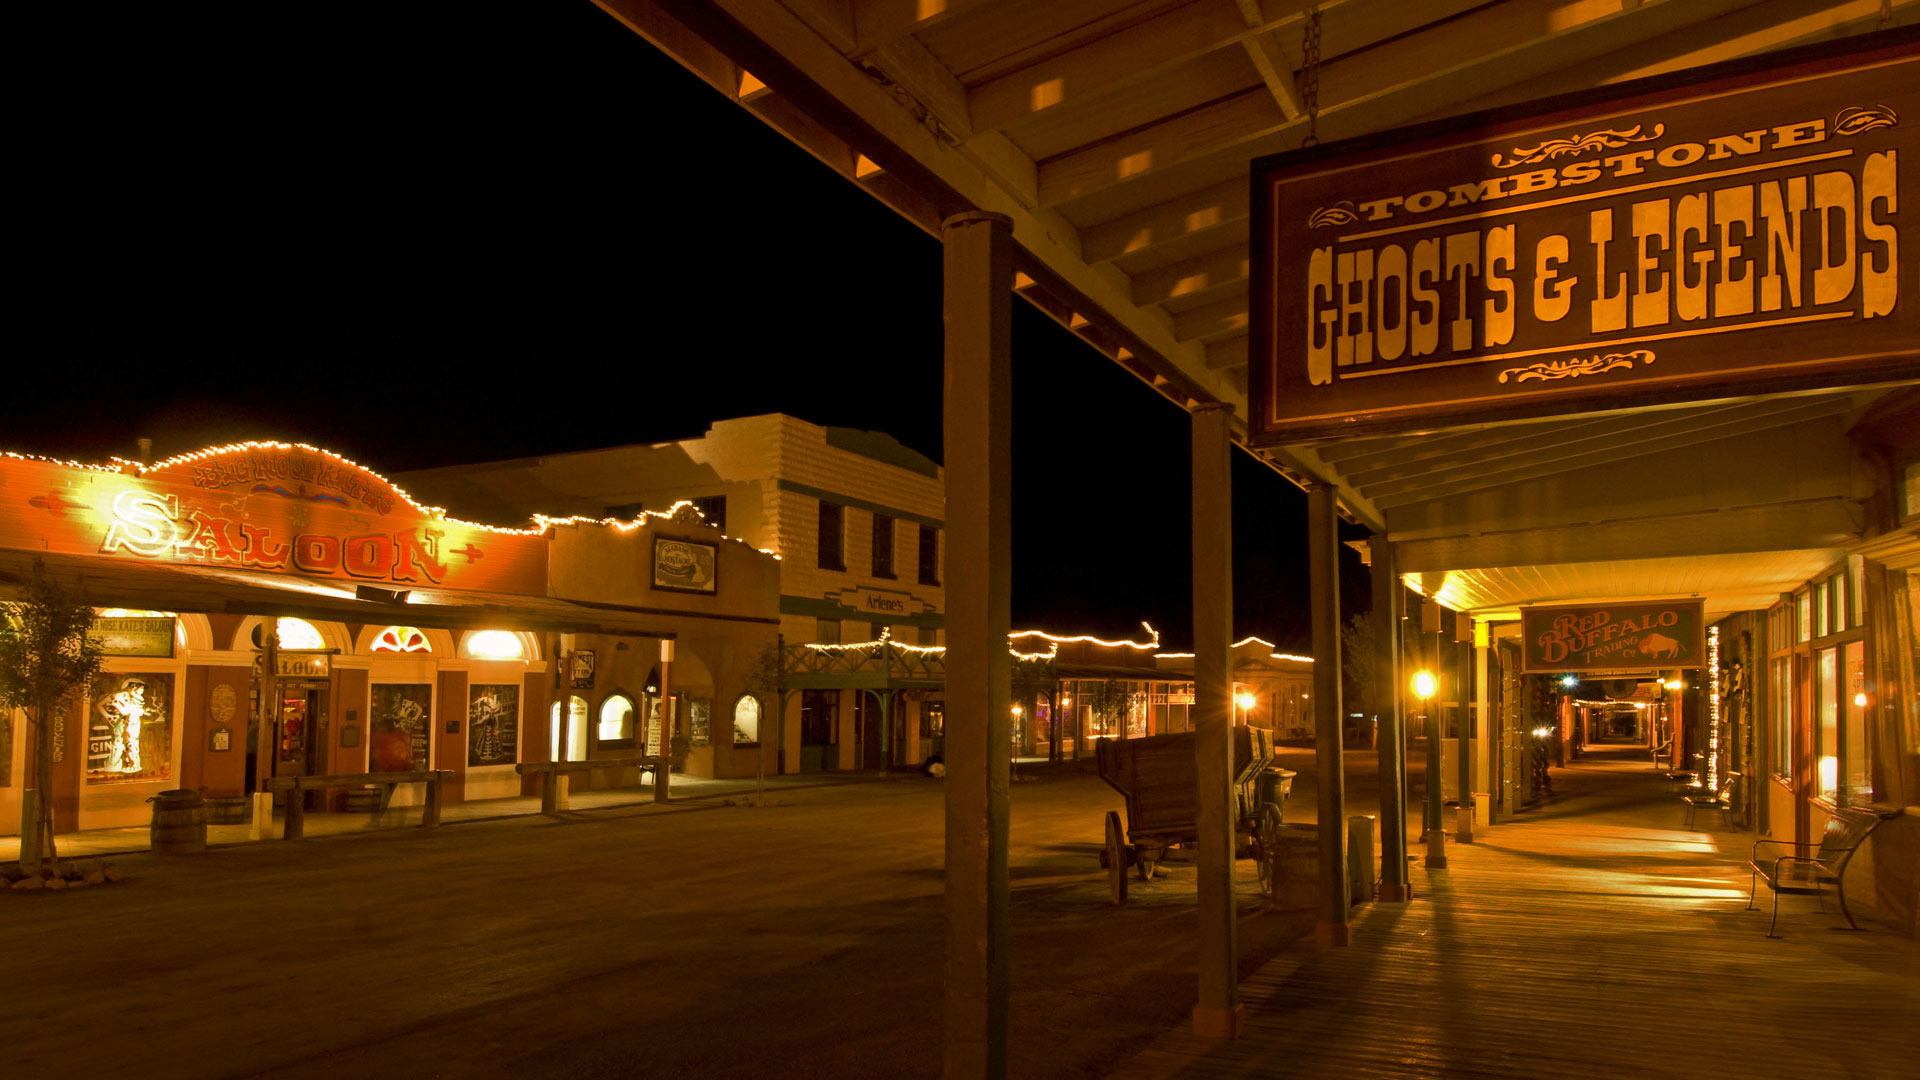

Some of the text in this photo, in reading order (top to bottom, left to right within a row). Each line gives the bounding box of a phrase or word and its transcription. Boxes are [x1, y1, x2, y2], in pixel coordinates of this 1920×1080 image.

[1359, 118, 1827, 222] TOMBSTONE
[1307, 149, 1899, 387] GHOSTS & LEGENDS
[192, 457, 250, 490] BIG
[250, 454, 318, 482] NOSE
[100, 489, 449, 584] SALOON
[866, 592, 904, 612] Arlene's
[1538, 610, 1679, 663] BUFFALO
[1553, 610, 1610, 640] RED
[1583, 636, 1639, 664] TRADING
[90, 741, 113, 752] GIN
